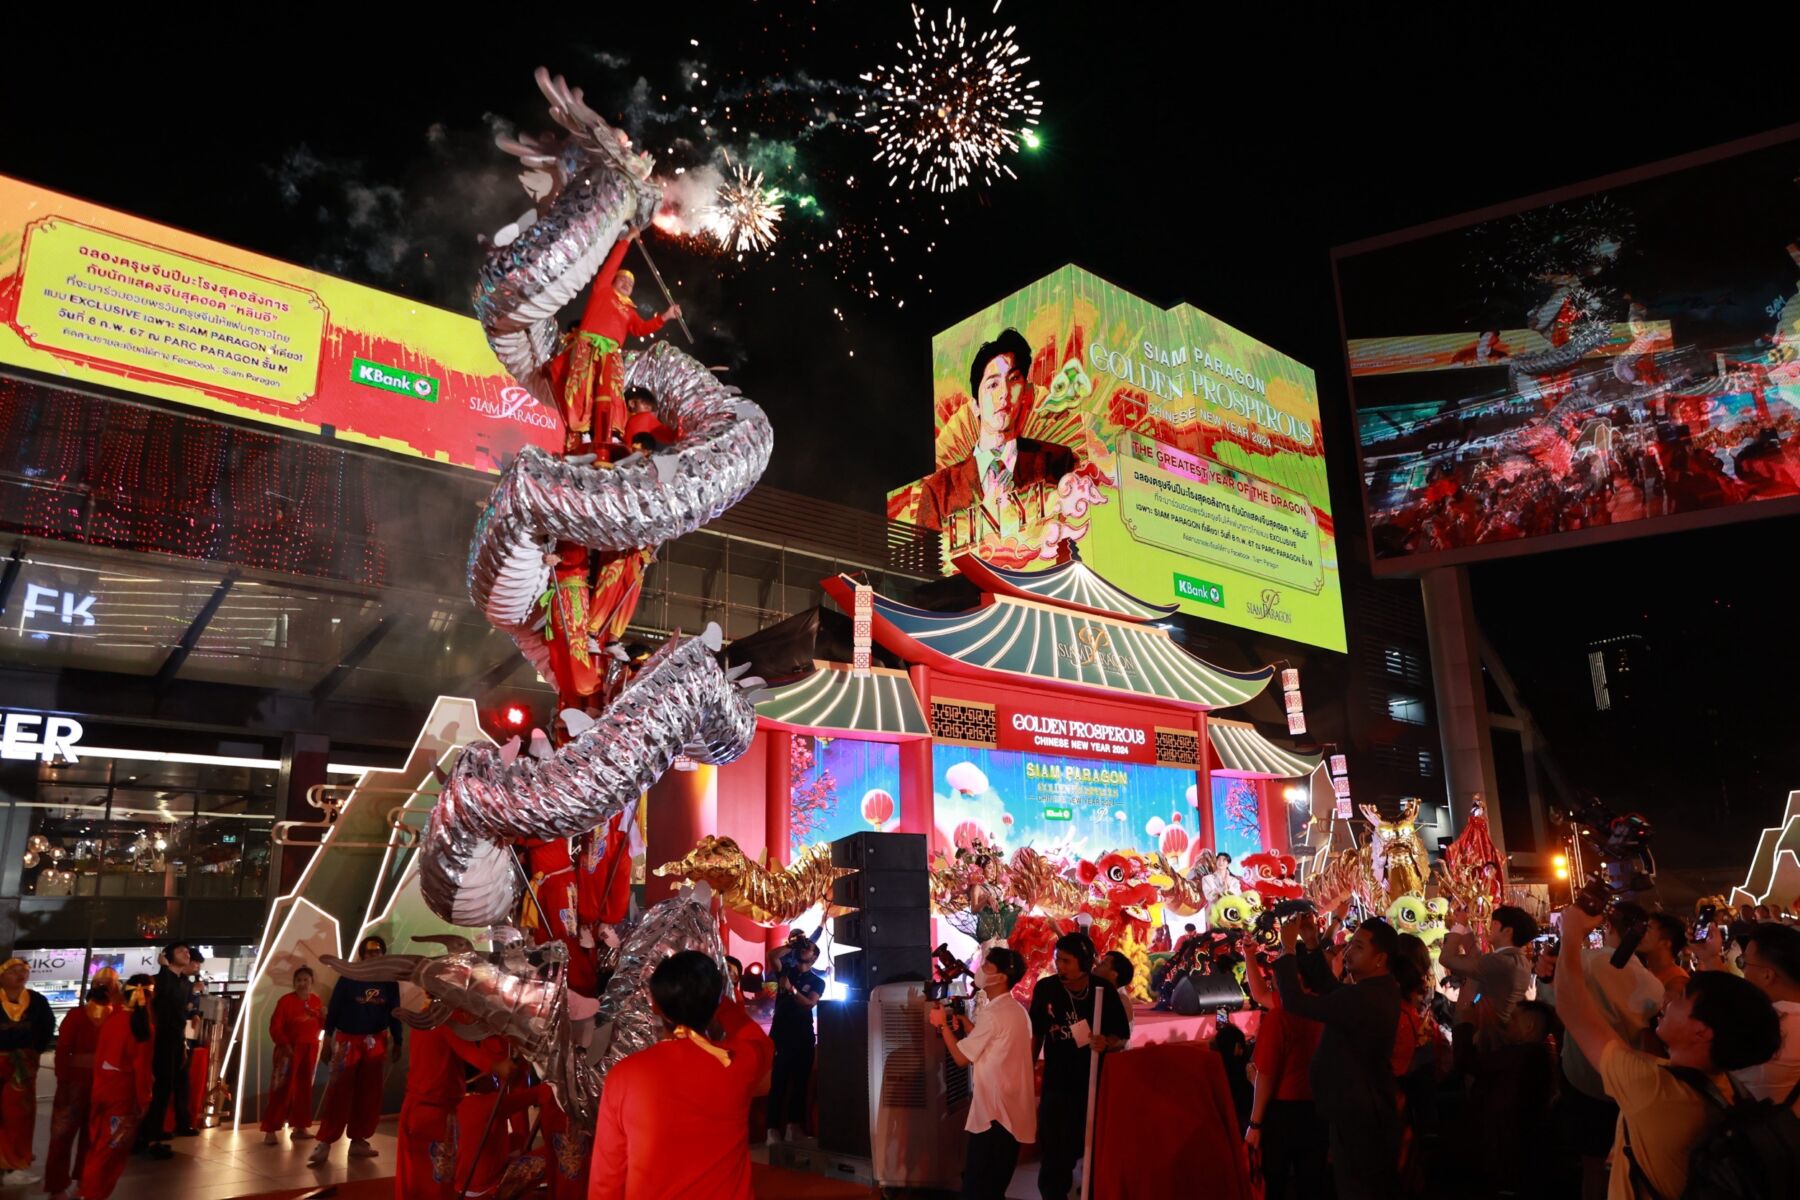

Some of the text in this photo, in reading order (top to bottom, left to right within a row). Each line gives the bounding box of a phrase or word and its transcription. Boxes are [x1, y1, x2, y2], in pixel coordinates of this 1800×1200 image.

[69, 294, 141, 320] EXCLUSIVE
[178, 322, 208, 337] SIAM
[210, 331, 267, 352] PARAGON
[88, 316, 97, 326] 8
[129, 327, 145, 338] 67
[163, 335, 198, 351] PARC
[200, 344, 260, 366] PARAGON
[278, 365, 288, 374] M
[172, 354, 215, 371] Facebook
[222, 367, 244, 378] Siam
[246, 373, 280, 387] Paragon
[359, 365, 411, 391] KBank
[1143, 340, 1266, 396] SIAM PARAGON
[1089, 342, 1314, 447] GOLDEN PROSPEROUS
[469, 397, 557, 430] SIAM PARAGON
[1148, 402, 1272, 449] CHINESE NEW YEAR 2024
[1132, 441, 1307, 516] THE GREATEST YEAR OF THE DRAGON
[1154, 508, 1170, 520] SIAM
[1171, 514, 1200, 530] PARAGON
[1178, 579, 1209, 599] KBank
[1246, 602, 1262, 614] SIAM
[0, 713, 83, 763] ER
[1012, 713, 1146, 745] GOLDEN PROSPEROUS
[1034, 735, 1129, 755] CHINESE NEW YEAR 2024
[1026, 762, 1128, 785] SIAM PARAGON
